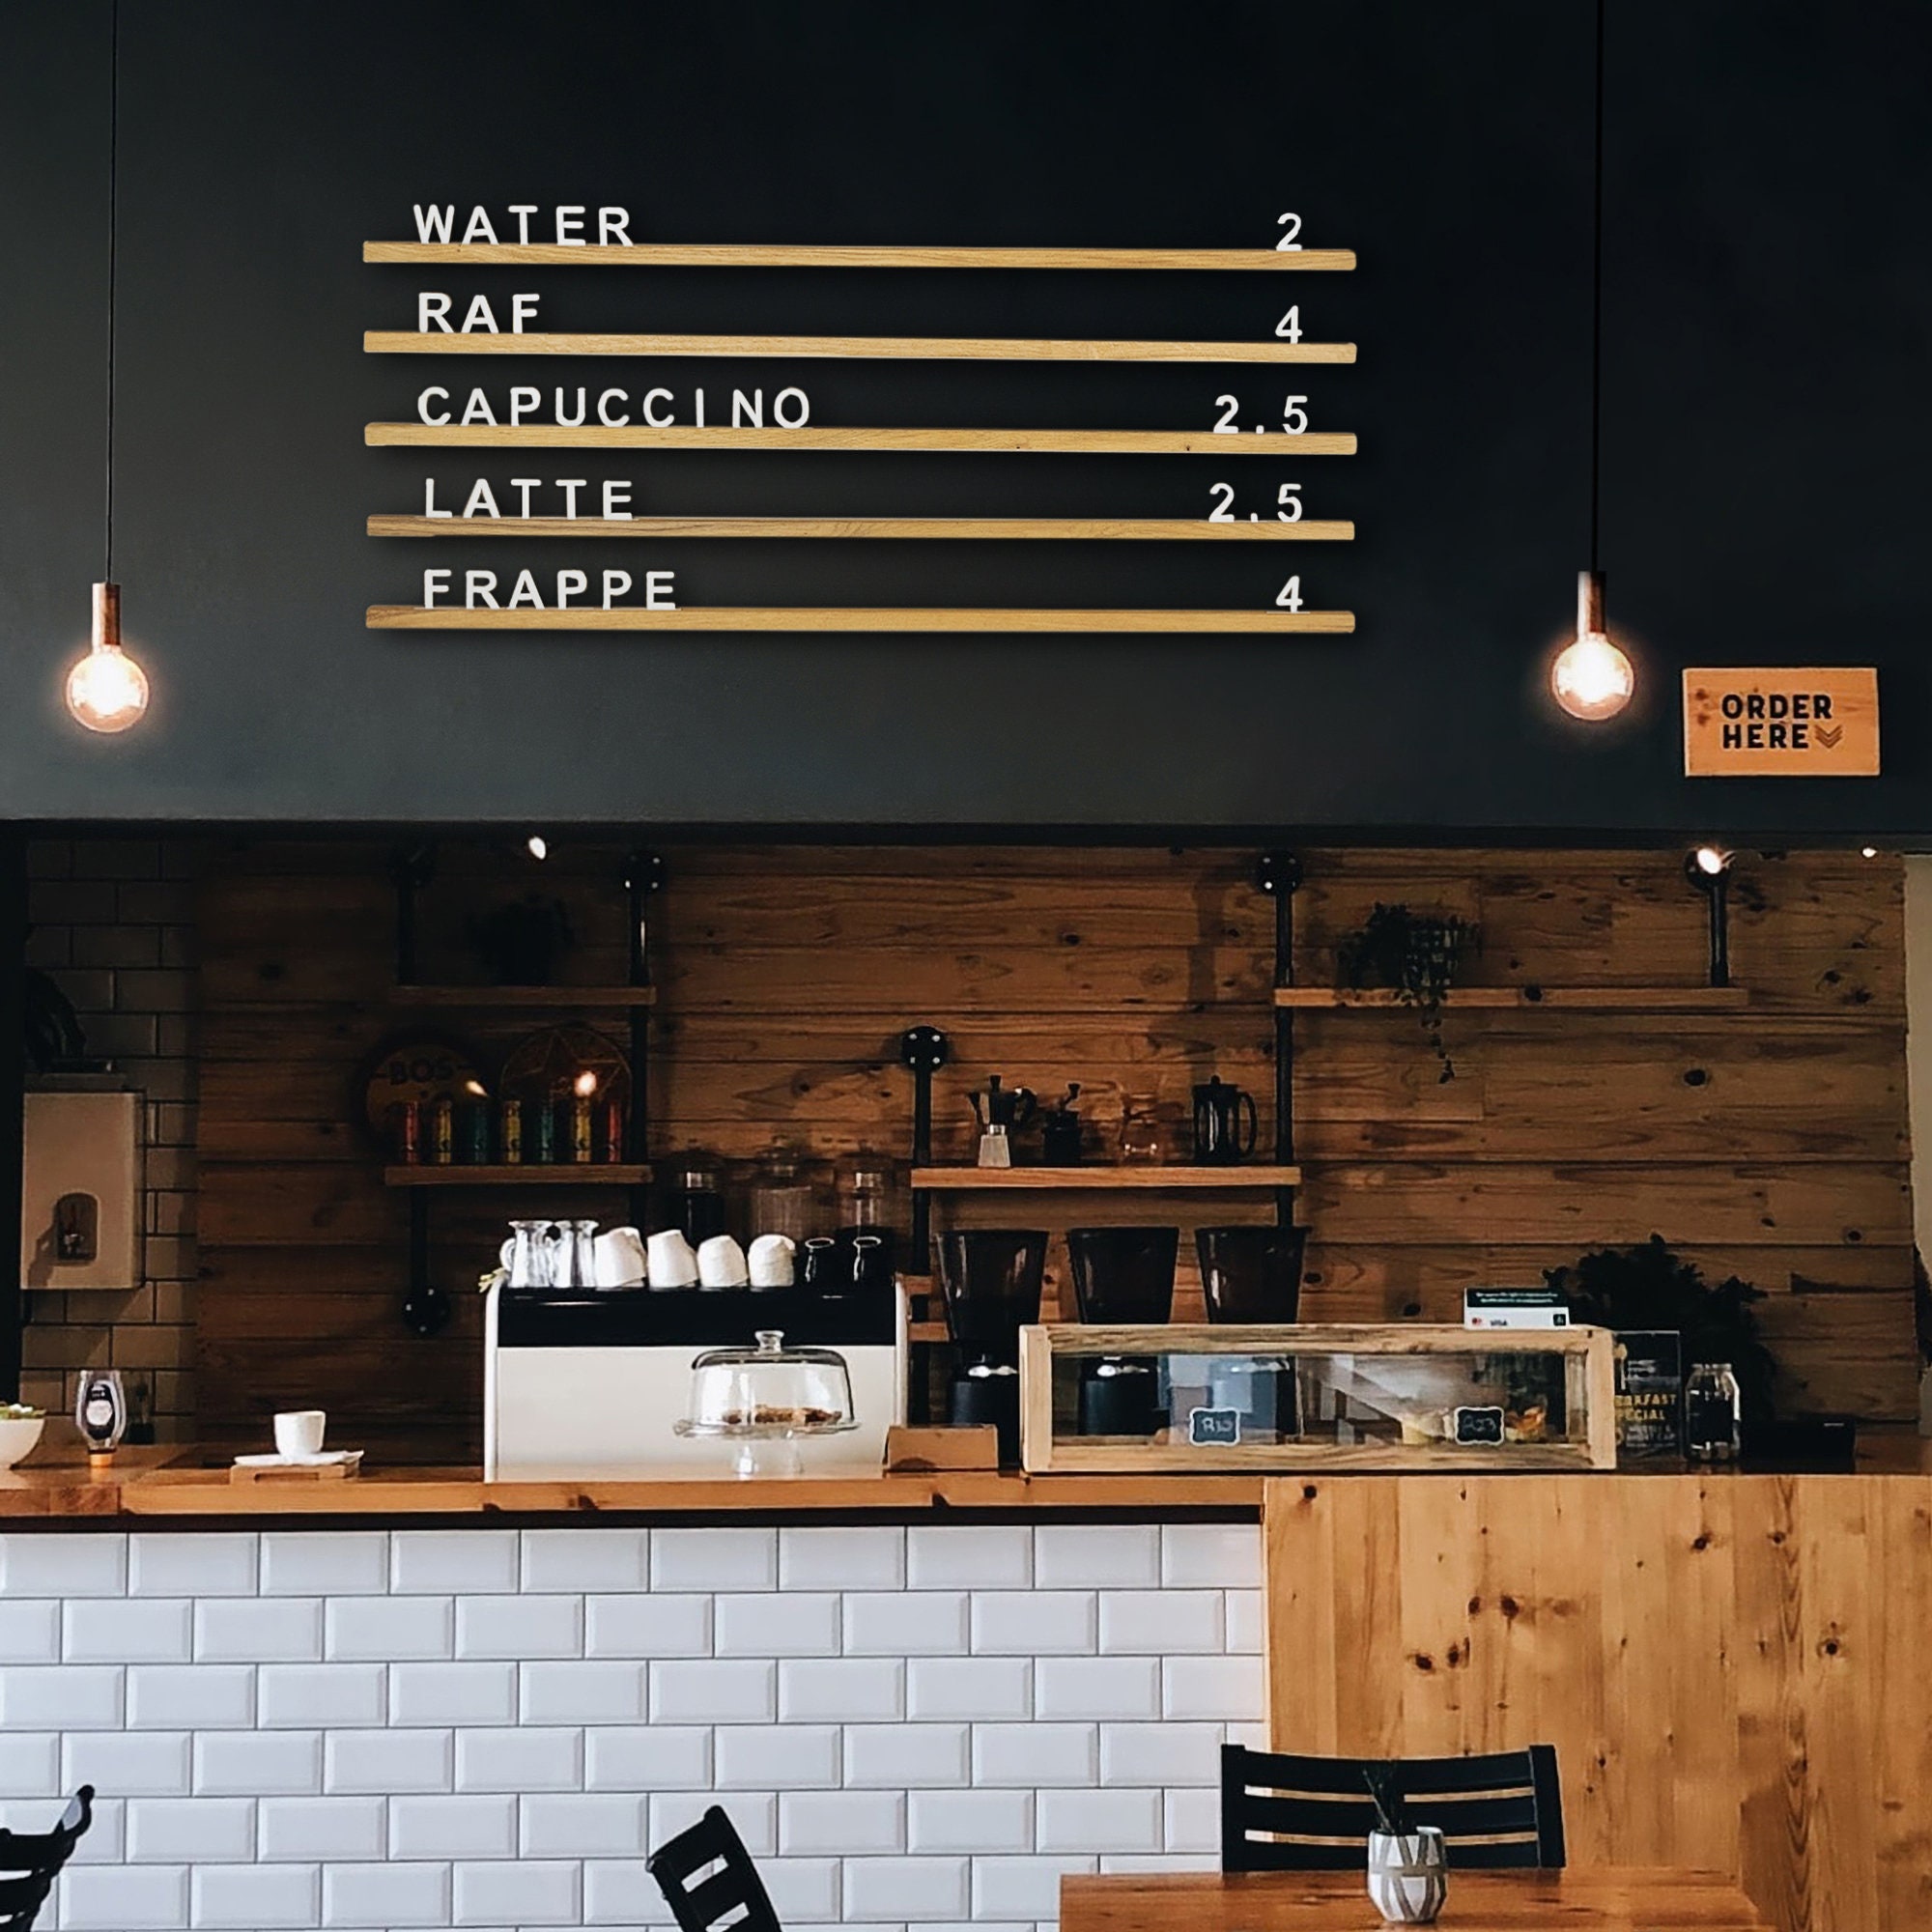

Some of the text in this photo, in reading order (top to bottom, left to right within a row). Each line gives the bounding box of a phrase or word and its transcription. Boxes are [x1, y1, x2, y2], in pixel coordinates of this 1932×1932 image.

[413, 204, 1302, 251] WATER 2
[418, 293, 1302, 344] RAF 4
[417, 386, 1308, 435] CAPUCCINO 2.5
[425, 478, 1302, 523] LATTE 2.5
[424, 569, 1303, 612] FRAPPE 4
[1721, 695, 1833, 719] ORDER
[1723, 724, 1808, 749] HERE
